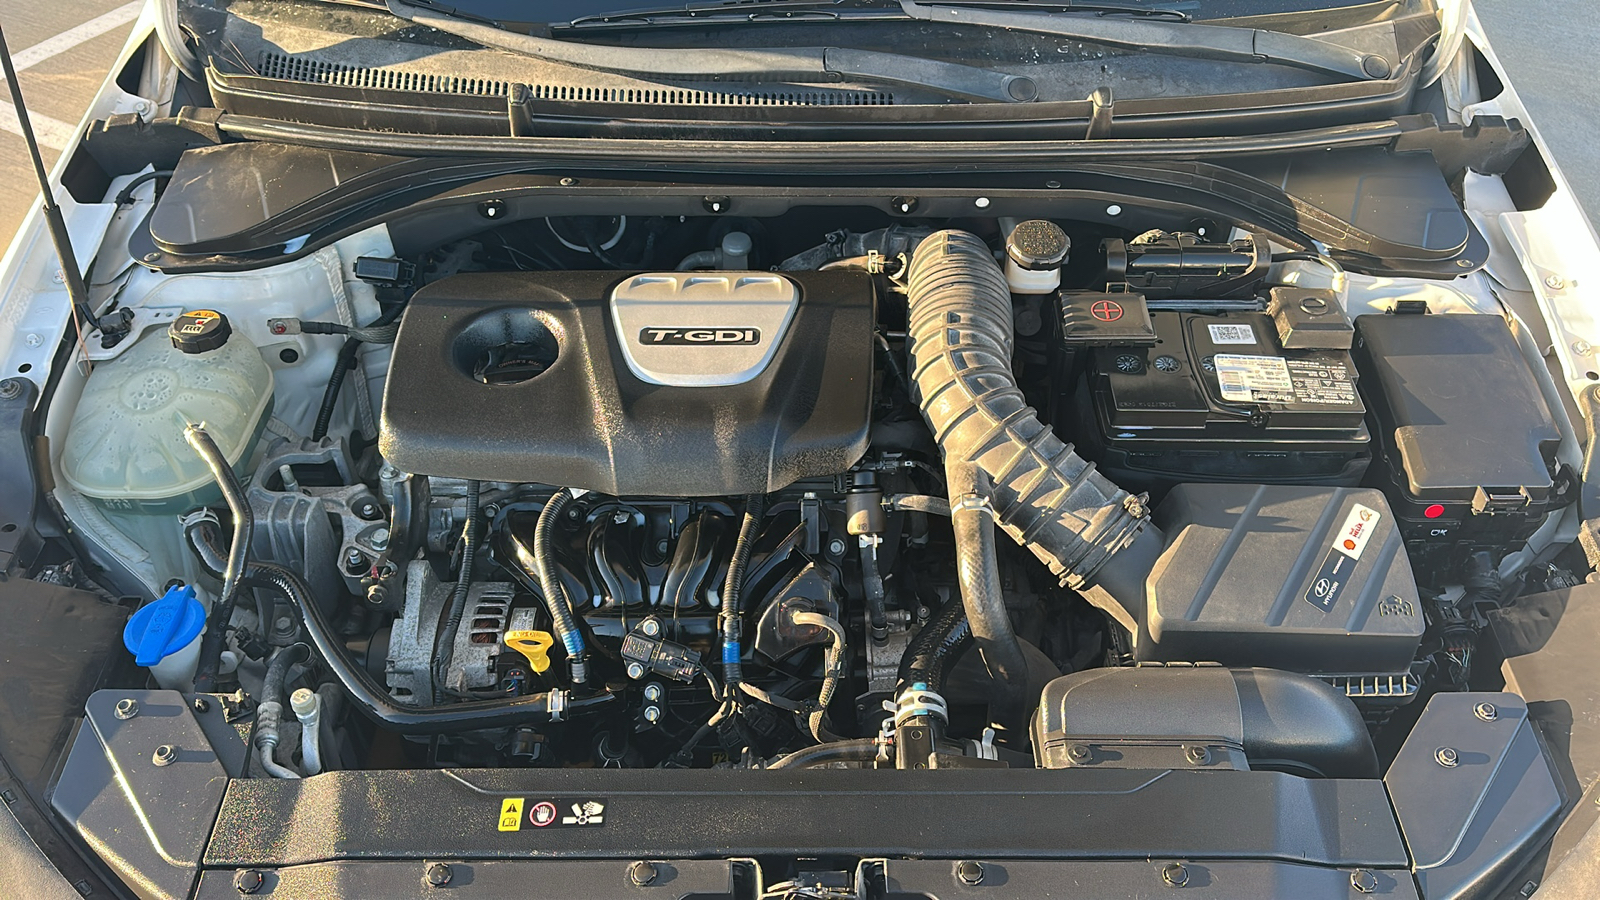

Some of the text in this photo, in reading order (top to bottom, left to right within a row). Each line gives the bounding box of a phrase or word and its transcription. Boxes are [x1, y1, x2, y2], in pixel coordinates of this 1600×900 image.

[647, 329, 754, 342] T-GDI
[1253, 392, 1292, 401] Duralast
[1430, 529, 1448, 537] OK
[1322, 581, 1340, 606] HYUNDAI
